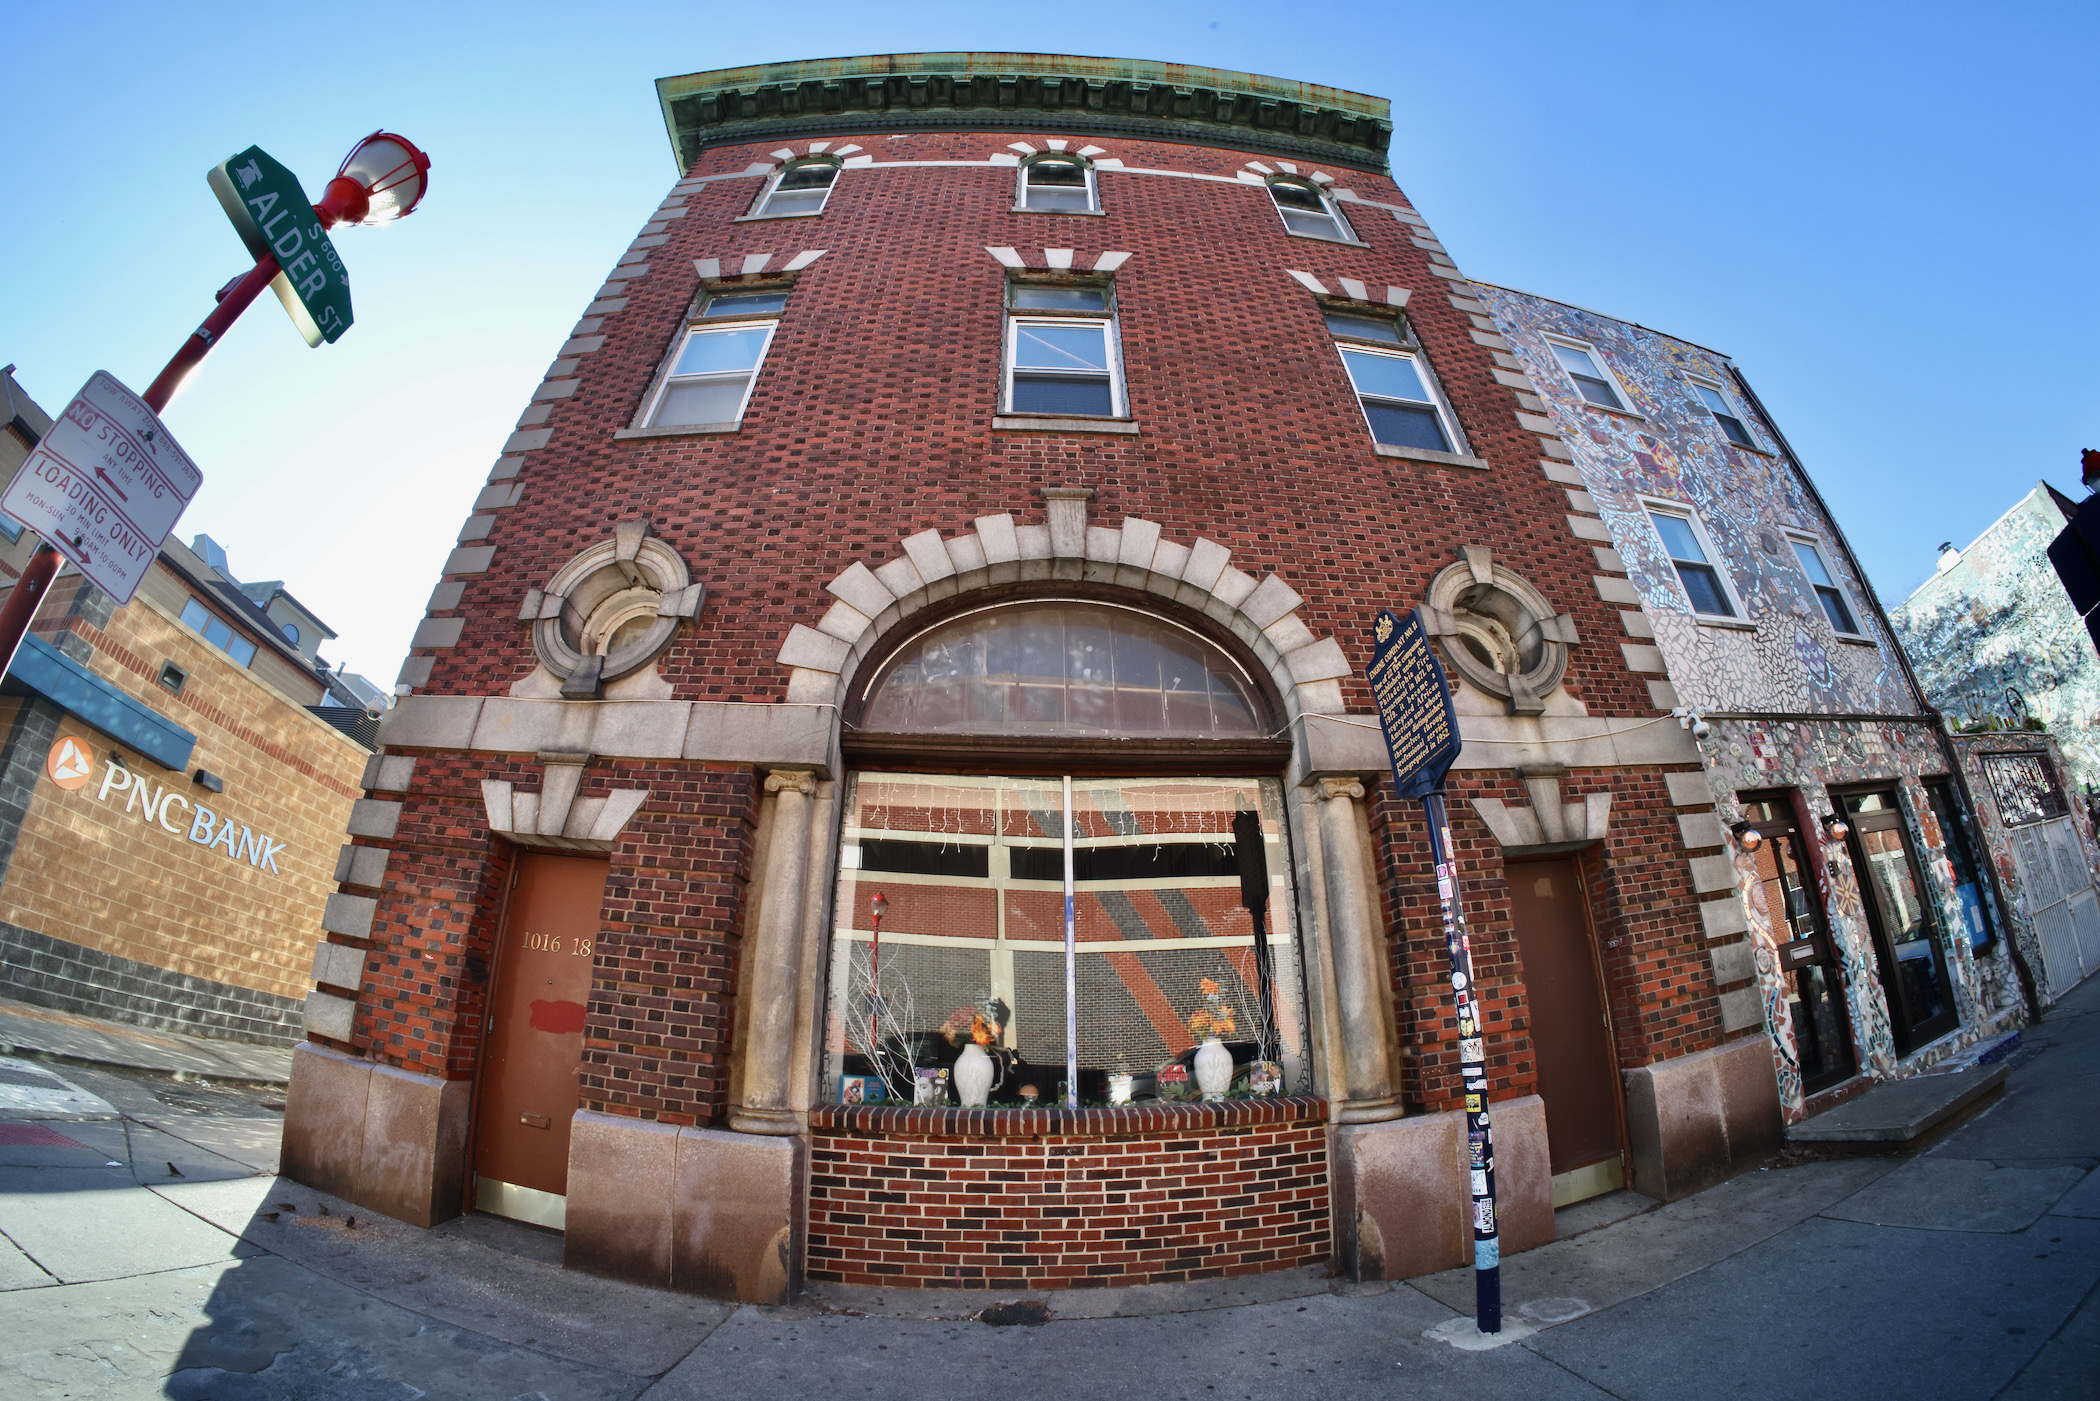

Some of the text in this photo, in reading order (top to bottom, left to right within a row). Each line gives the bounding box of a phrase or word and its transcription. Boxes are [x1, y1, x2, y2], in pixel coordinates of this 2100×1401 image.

[248, 192, 342, 334] ALDER ST
[308, 222, 342, 272] S 600
[99, 379, 118, 396] TOW
[120, 396, 142, 415] AWAY
[142, 416, 160, 437] ZONE
[68, 402, 165, 499] NO STOPPING
[102, 453, 133, 486] ANY TIME
[26, 491, 65, 522] MON-SUN
[34, 459, 147, 562] LOADING ONLY
[65, 503, 109, 547] 30 MIN LIMIT
[1369, 658, 1386, 680] ENGINE
[1384, 635, 1405, 663] COMPANY
[1399, 636, 1423, 663] companies
[1402, 655, 1416, 674] under
[1379, 654, 1430, 712] Philadelphia Fire
[1382, 686, 1408, 720] Department
[1406, 680, 1428, 704] became
[1388, 682, 1439, 738] segregated African
[1391, 691, 1441, 742] American unit whose
[1412, 698, 1444, 733] distinguished
[1394, 709, 1446, 759] themselves through
[1396, 738, 1425, 769] professional
[98, 759, 287, 875] PNC BANK
[522, 932, 592, 957] 1016 18
